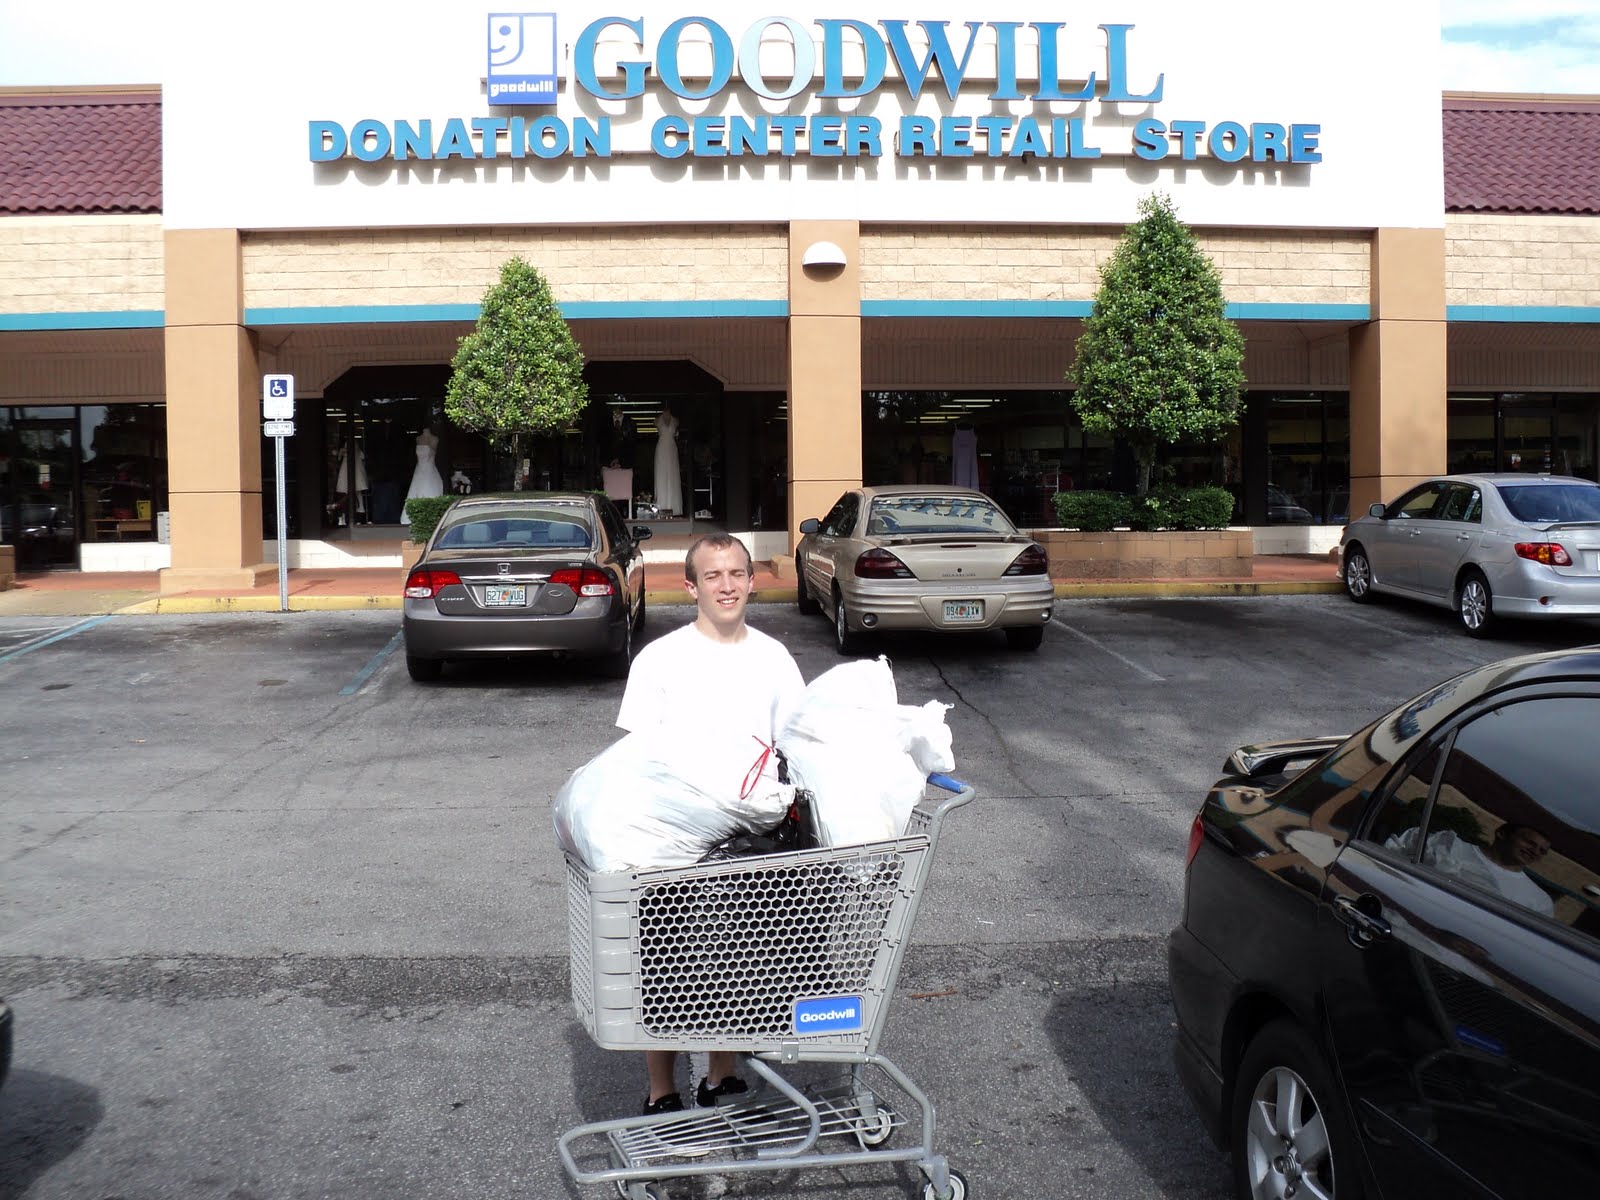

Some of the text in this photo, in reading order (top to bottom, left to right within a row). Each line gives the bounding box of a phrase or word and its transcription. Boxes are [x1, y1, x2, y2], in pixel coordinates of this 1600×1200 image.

[574, 16, 1164, 103] GOODWILL
[490, 80, 554, 98] goodwill
[309, 115, 1322, 164] DONATION CENTER RETAIL STORE
[800, 1008, 856, 1023] Goodwill
